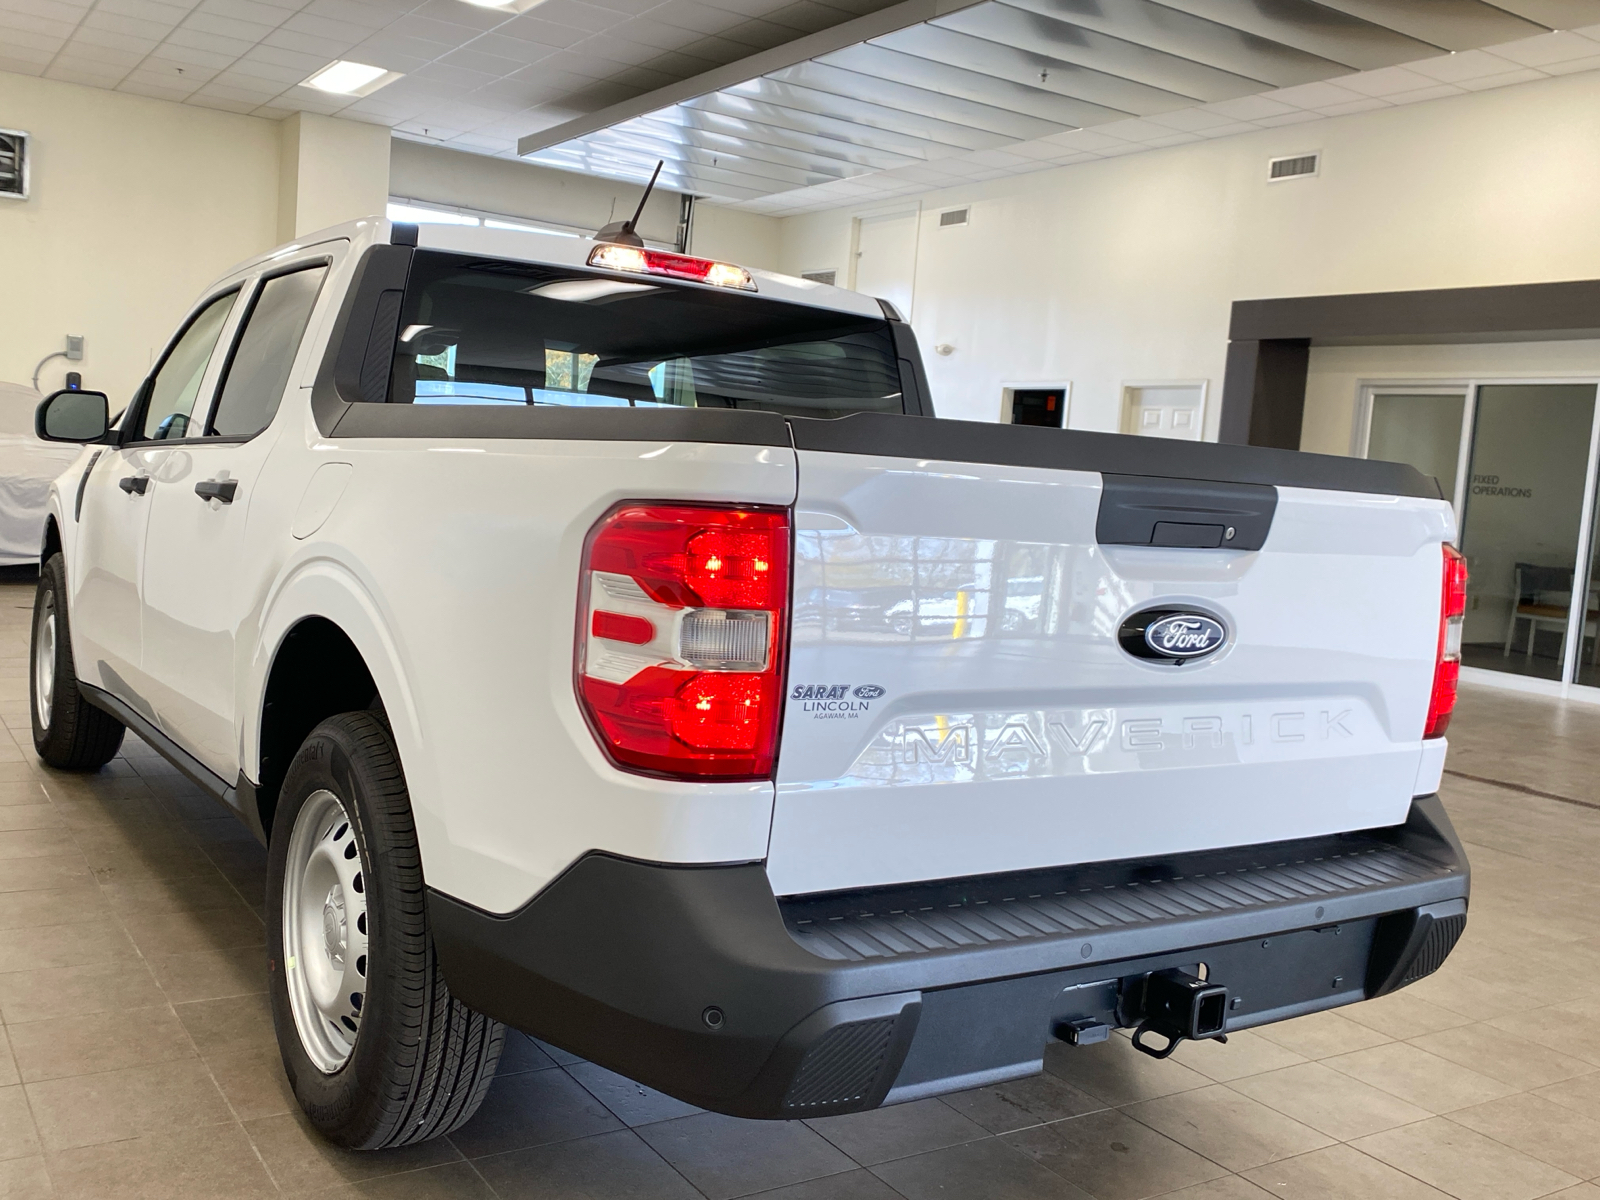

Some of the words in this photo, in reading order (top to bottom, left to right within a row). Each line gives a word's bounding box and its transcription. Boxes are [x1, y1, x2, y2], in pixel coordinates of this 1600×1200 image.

[1473, 475, 1499, 485] FIXED
[1473, 486, 1532, 498] OPERATIONS
[1163, 621, 1211, 648] Ford
[790, 684, 851, 700] SARAT
[803, 701, 870, 711] LINCOLN
[813, 712, 847, 720] AGAWAM,
[903, 709, 1354, 764] MAVERICK
